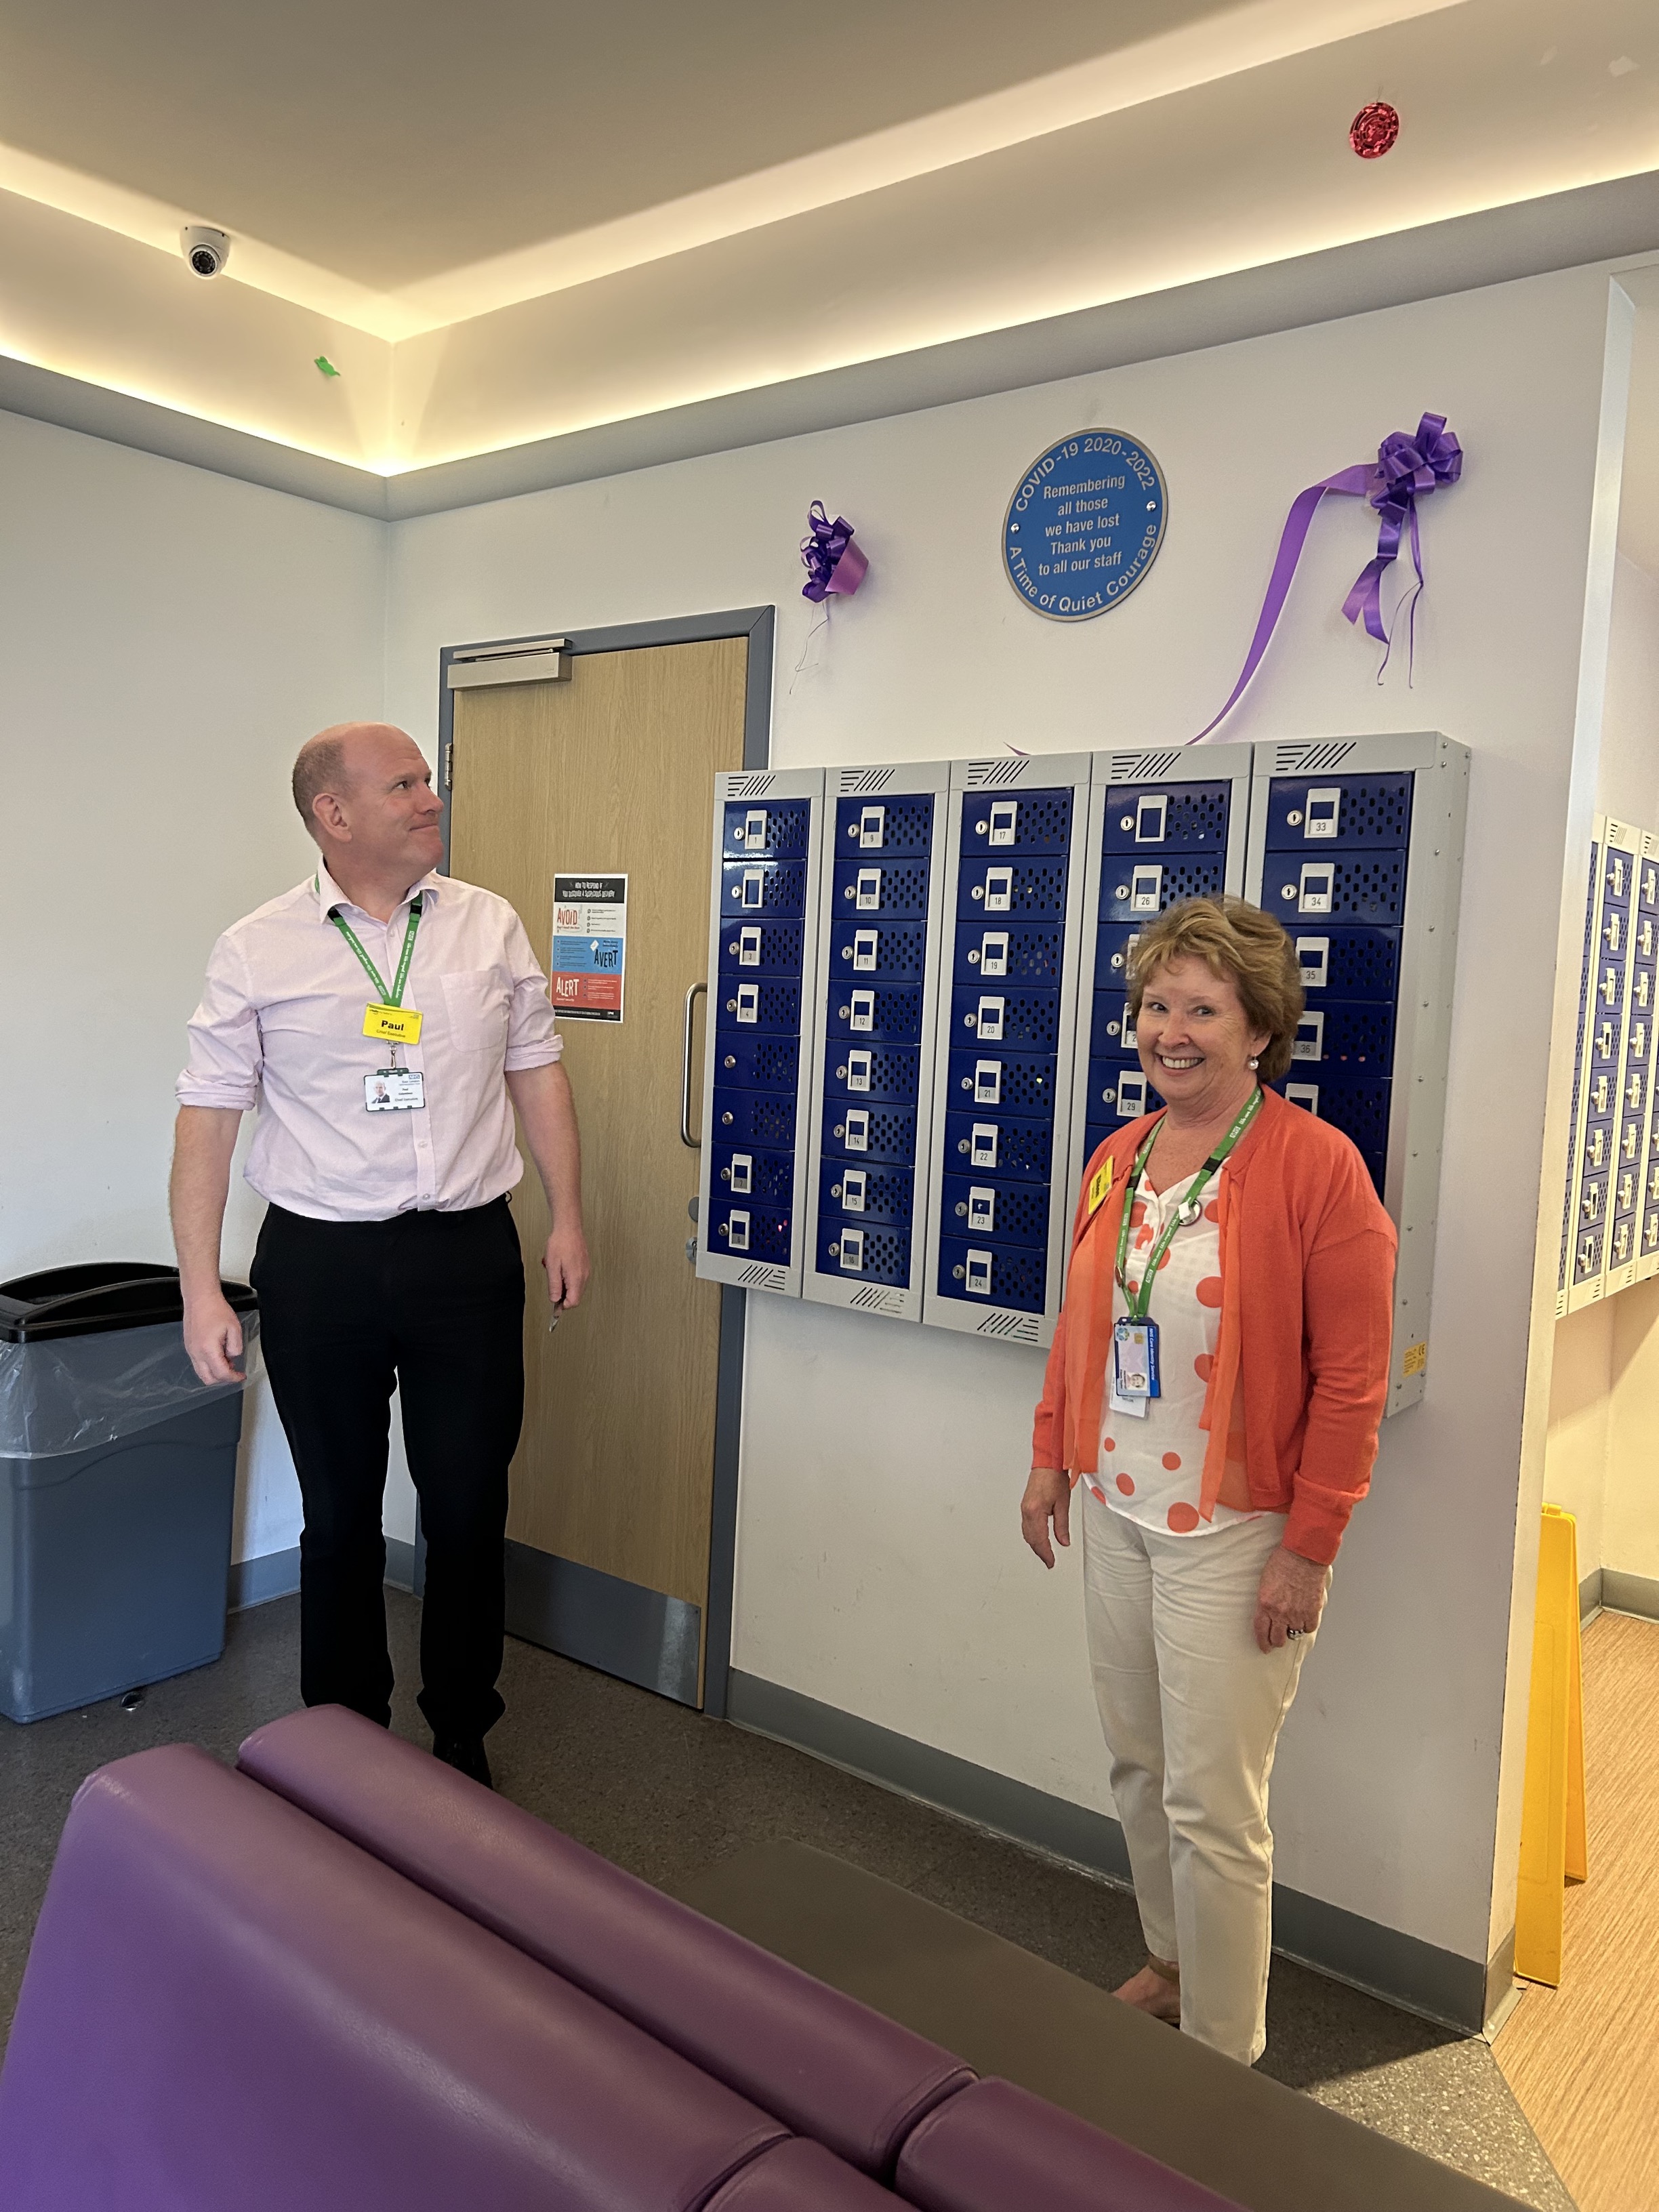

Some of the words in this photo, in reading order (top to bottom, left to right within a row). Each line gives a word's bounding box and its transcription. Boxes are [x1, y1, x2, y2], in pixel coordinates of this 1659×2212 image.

[1017, 442, 1079, 512] COVID-19
[1084, 437, 1155, 491] 2020-2022
[1043, 475, 1125, 499] Remembering
[1057, 501, 1072, 516] all
[1076, 497, 1108, 514] those
[1045, 525, 1062, 537] we
[1065, 520, 1094, 534] have
[1097, 513, 1120, 529] lost
[1050, 539, 1086, 555] Thank
[1090, 535, 1111, 552] you
[1010, 547, 1022, 560] A
[1038, 562, 1050, 576] to
[1053, 560, 1067, 574] all
[1071, 558, 1090, 571] our
[1094, 551, 1122, 568] staff
[1106, 524, 1157, 596] Courage
[1013, 558, 1038, 598] Time
[1040, 594, 1056, 609] of
[1059, 591, 1103, 613] Quiet
[1316, 822, 1326, 832] 33
[1000, 831, 1006, 839] 17
[995, 897, 1002, 905] 18
[1141, 897, 1150, 905] 26
[1311, 897, 1322, 906] 34
[557, 907, 577, 926] AVOID
[594, 949, 619, 968] AVERT
[991, 961, 998, 970] 19
[1306, 970, 1315, 979] 35
[556, 977, 579, 997] ALERT
[381, 1020, 405, 1031] Paul
[859, 1017, 865, 1025] 12
[987, 1025, 995, 1033] 20
[1300, 1044, 1310, 1053] 36
[857, 1078, 863, 1086] 13
[984, 1089, 991, 1097] 21
[1127, 1102, 1136, 1111] 29
[980, 1152, 988, 1161] 22
[852, 1197, 857, 1206] 15
[977, 1216, 985, 1225] 23
[975, 1278, 982, 1287] 24
